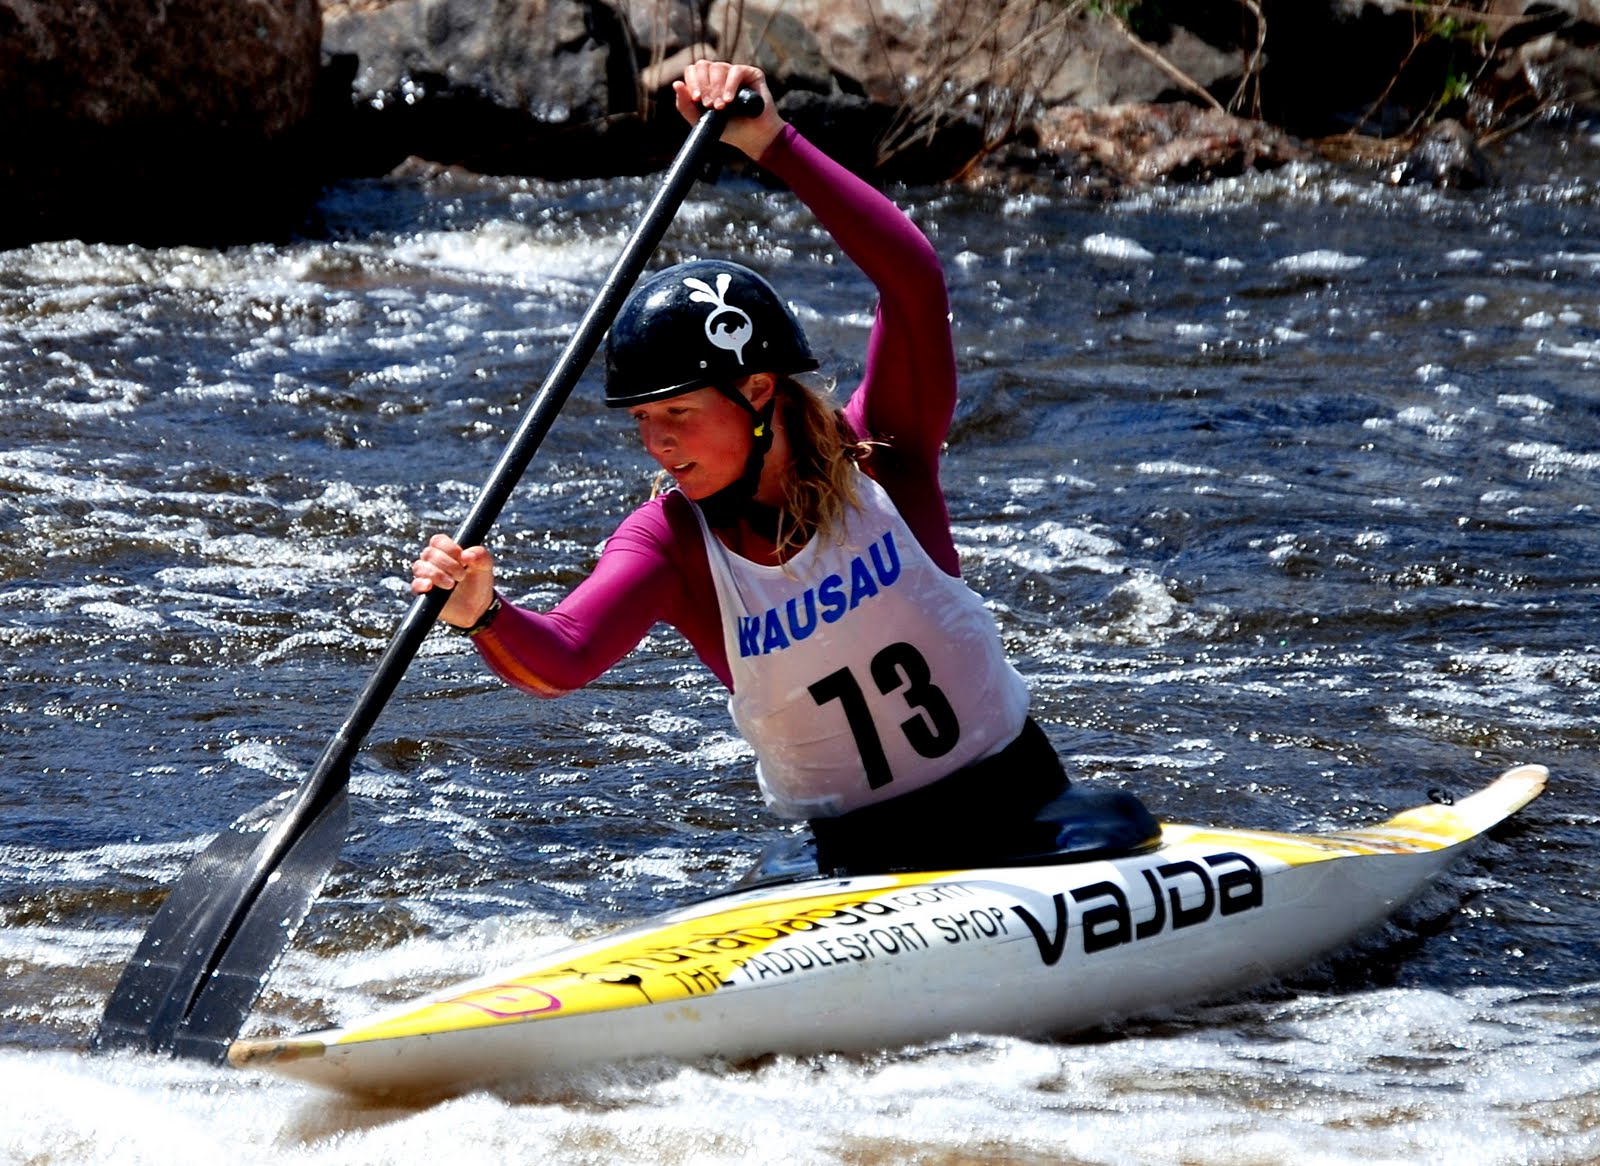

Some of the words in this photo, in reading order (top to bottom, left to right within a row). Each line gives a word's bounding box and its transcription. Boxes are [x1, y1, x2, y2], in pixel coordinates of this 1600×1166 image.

[807, 641, 960, 790] 73
[664, 964, 735, 995] THE
[733, 922, 930, 982] PADDLESPORT
[932, 906, 1009, 945] SHOP
